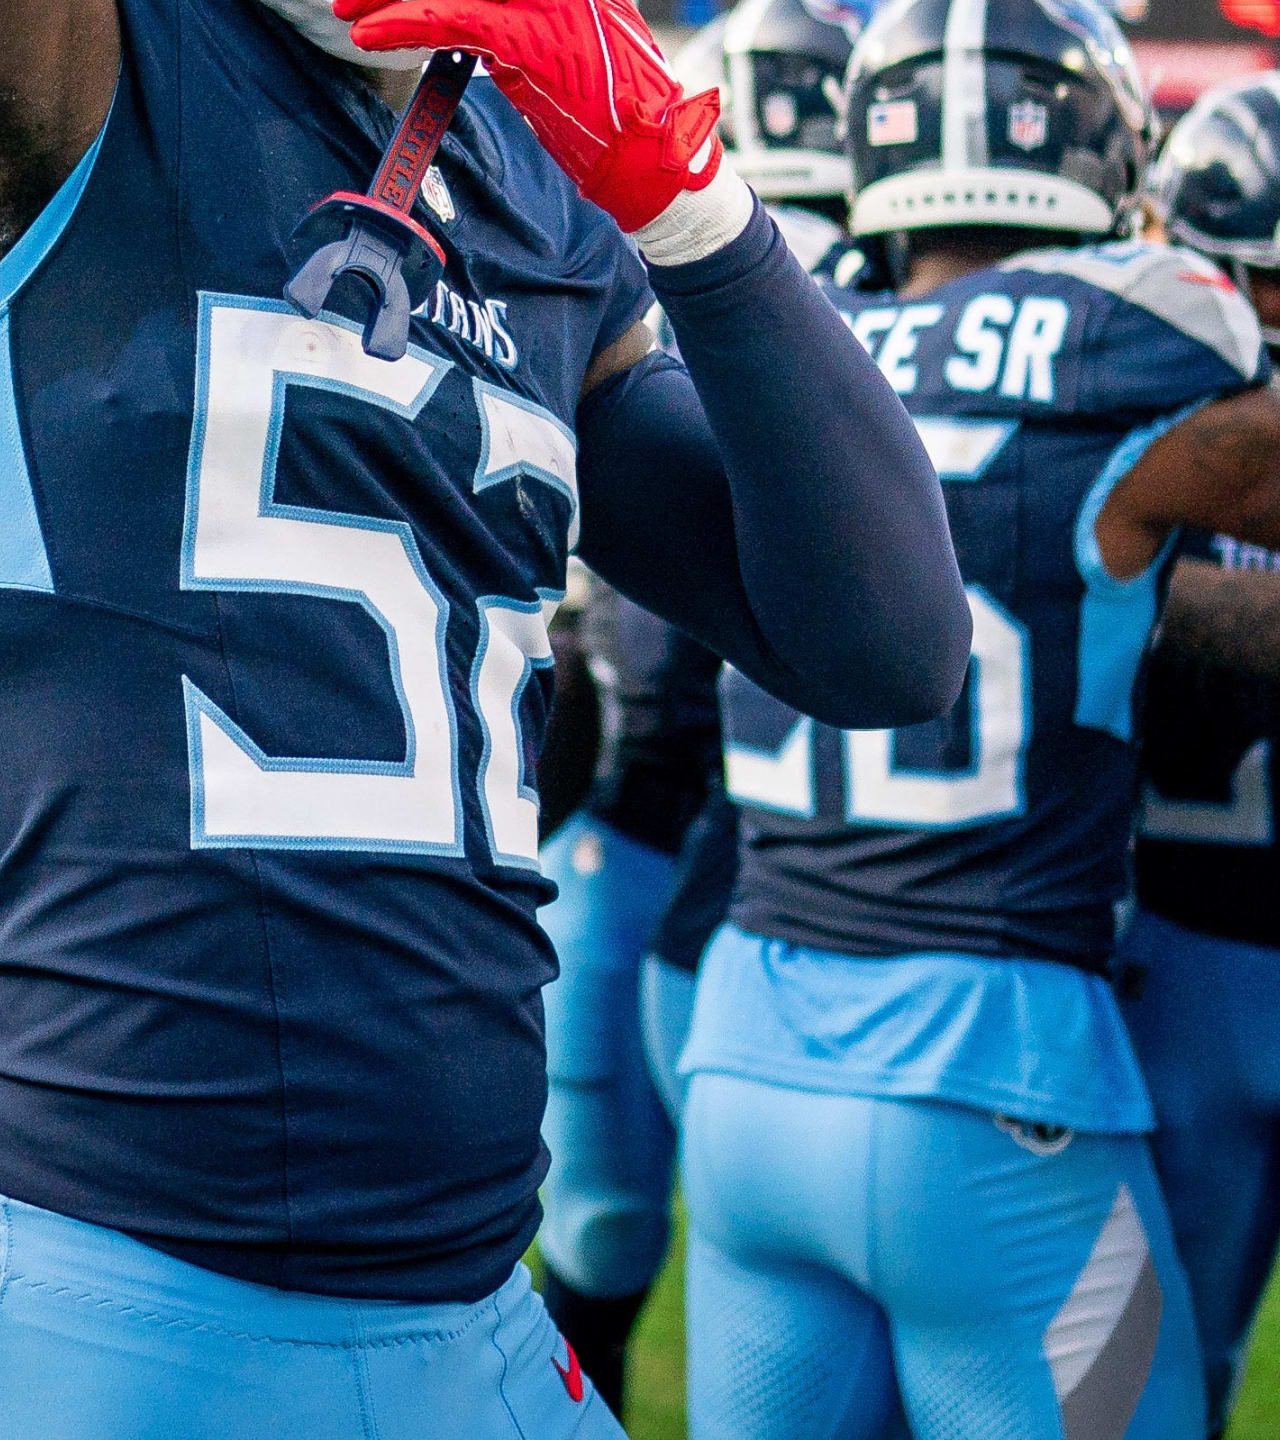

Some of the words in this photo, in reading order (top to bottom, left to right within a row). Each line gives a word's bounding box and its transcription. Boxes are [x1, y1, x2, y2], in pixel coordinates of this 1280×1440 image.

[380, 87, 453, 207] BATTLE
[410, 279, 518, 372] TANS
[943, 292, 1070, 405] SR
[181, 291, 578, 870] 52
